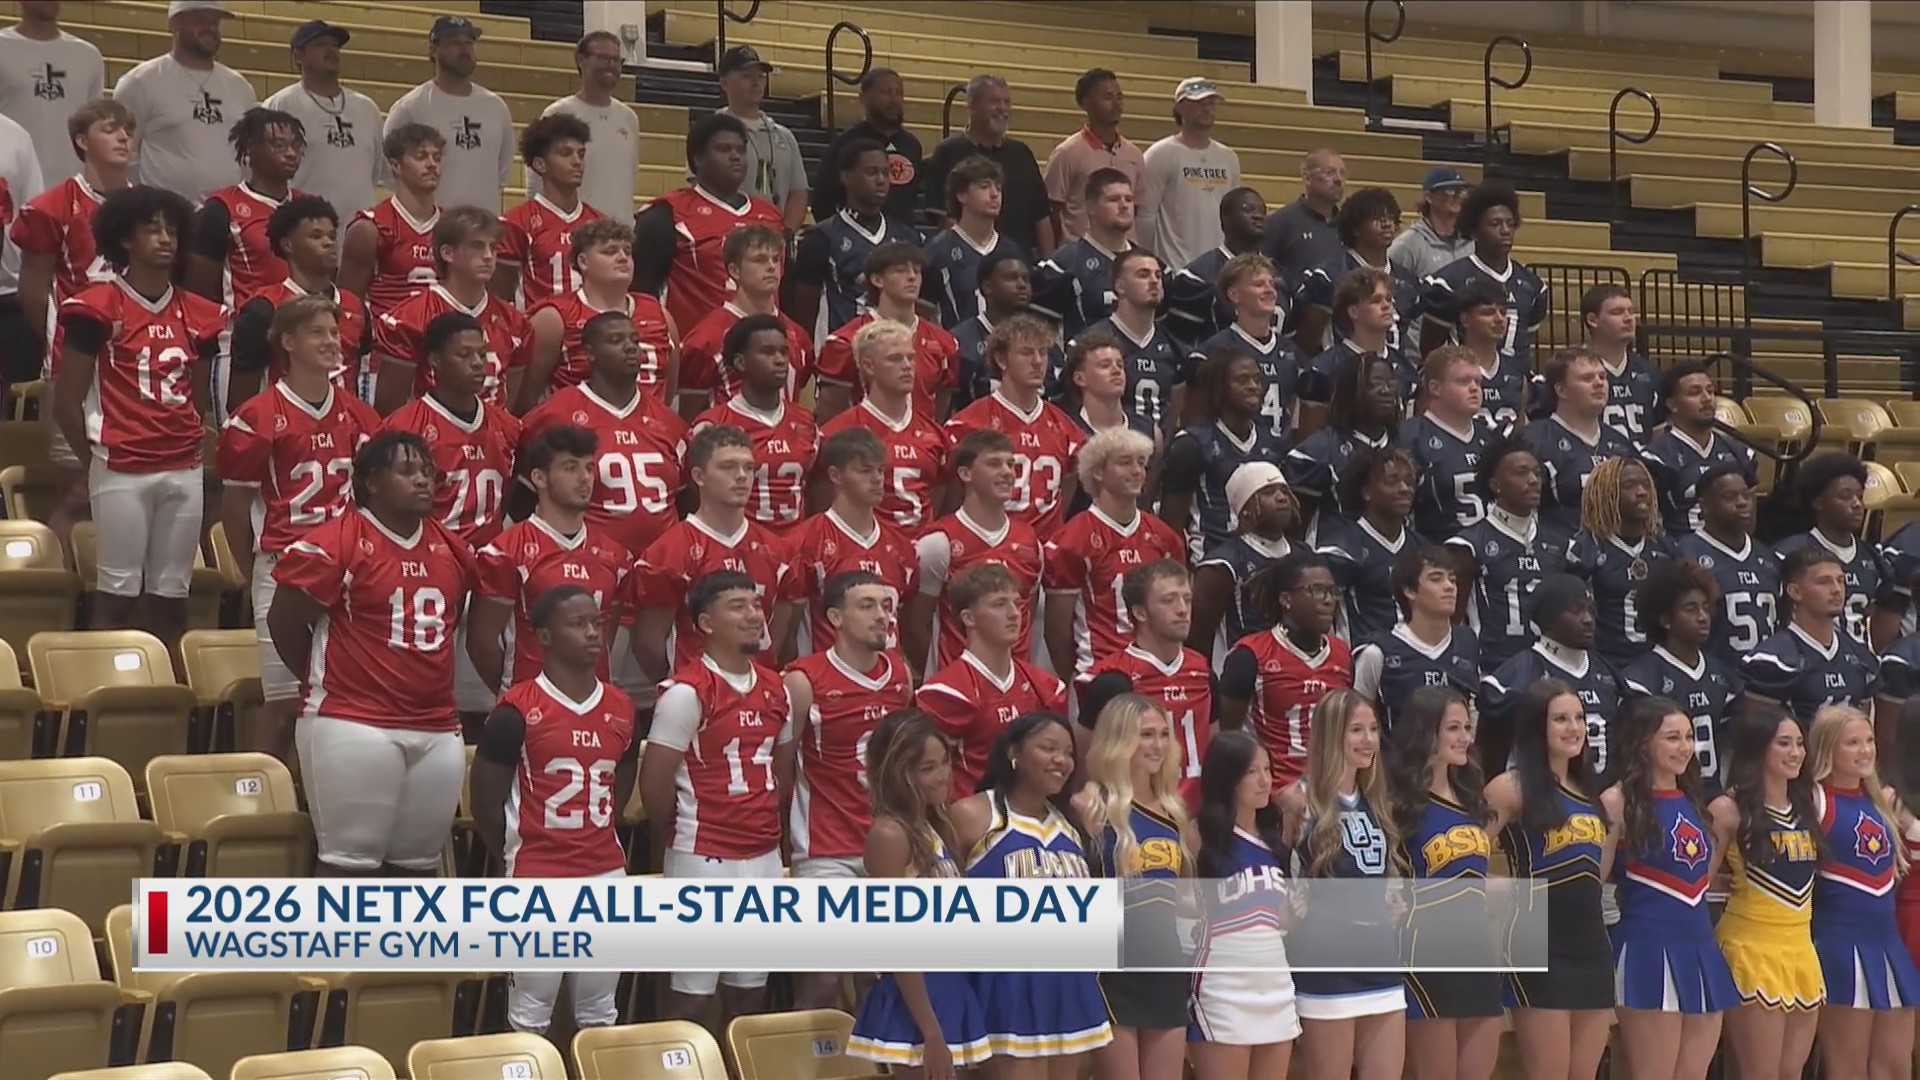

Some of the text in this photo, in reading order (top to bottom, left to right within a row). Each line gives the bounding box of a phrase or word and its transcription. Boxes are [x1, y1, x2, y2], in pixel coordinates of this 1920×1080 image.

[148, 325, 174, 339] FCA
[1137, 358, 1157, 372] FCA
[137, 346, 188, 404] 12
[1612, 385, 1632, 398] FCA
[311, 433, 335, 450] FCA
[615, 430, 639, 445] FCA
[1020, 433, 1041, 448] FCA
[463, 445, 485, 461] FCA
[768, 439, 790, 454] FCA
[894, 445, 917, 460] FCA
[290, 457, 353, 525] 23
[598, 452, 669, 514] 95
[446, 469, 503, 530] 70
[755, 462, 804, 522] 13
[893, 467, 922, 526] 5
[1119, 549, 1142, 564] FCA
[1517, 557, 1541, 571] FCA
[401, 561, 428, 578] FCA
[563, 563, 590, 580] FCA
[859, 561, 883, 576] FCA
[1737, 570, 1760, 585] FCA
[1845, 573, 1860, 587] CA
[388, 586, 446, 651] 18
[1725, 591, 1777, 651] 53
[1424, 671, 1449, 687] FCA
[1824, 673, 1847, 688] FCA
[1163, 686, 1188, 701] FCA
[1689, 692, 1711, 708] FCA
[740, 711, 763, 727] FCA
[864, 705, 888, 721] FCA
[997, 704, 1020, 724] FCA
[573, 730, 601, 748] FCA
[722, 736, 776, 796] 14
[544, 757, 617, 829] 26
[33, 941, 52, 955] 10
[817, 1040, 833, 1054] 14
[667, 1052, 685, 1066] 13
[509, 1065, 525, 1078] 12
